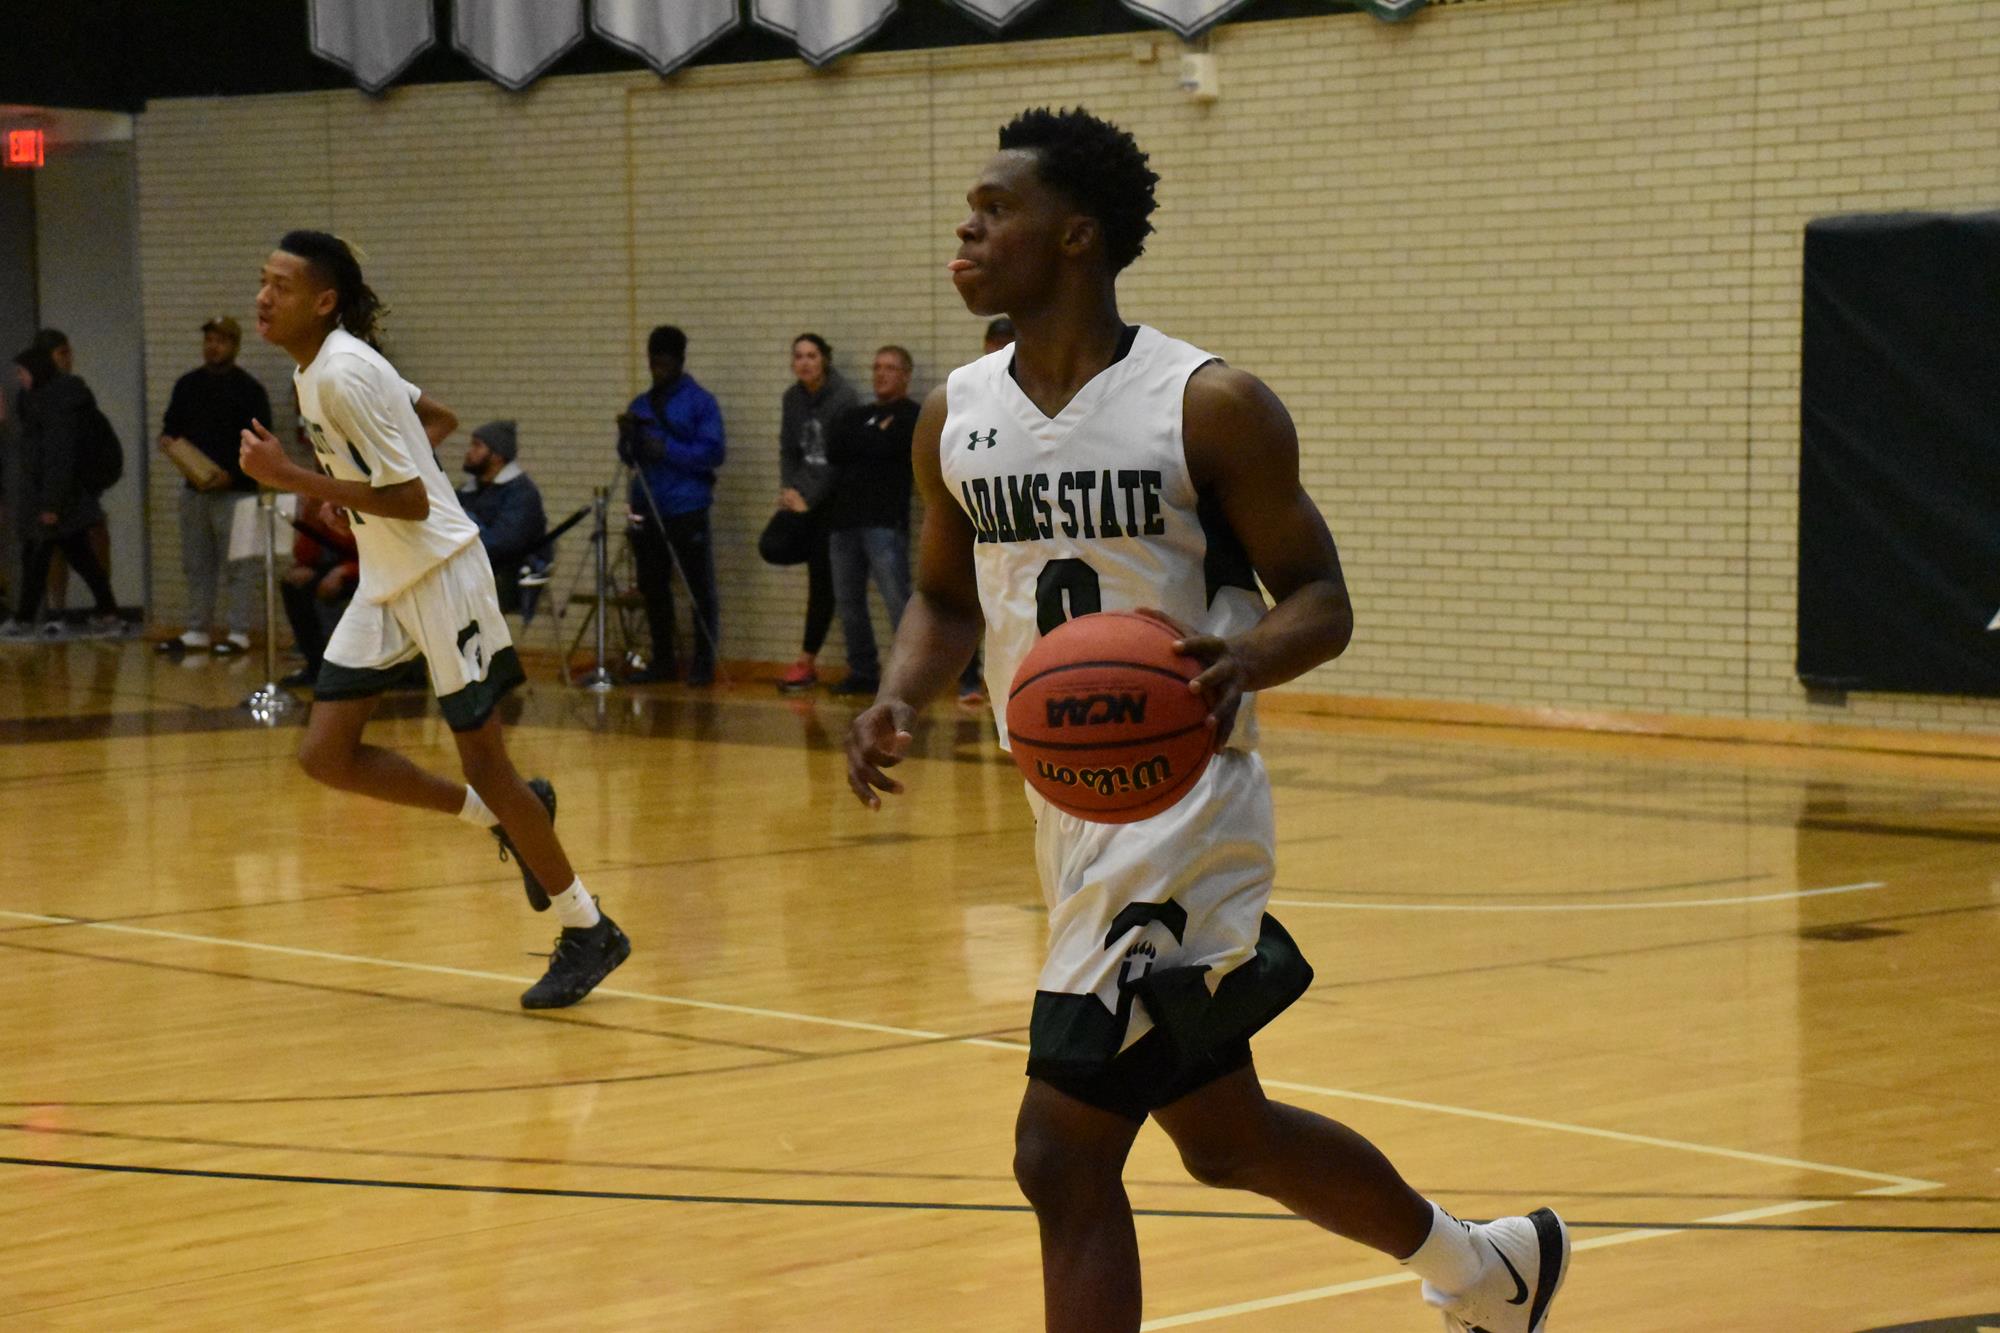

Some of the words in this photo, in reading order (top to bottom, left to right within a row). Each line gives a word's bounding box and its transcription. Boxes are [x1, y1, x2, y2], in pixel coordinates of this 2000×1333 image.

[1058, 469, 1165, 539] STATE
[1045, 692, 1147, 728] NCAA
[1035, 754, 1174, 796] Wilson
